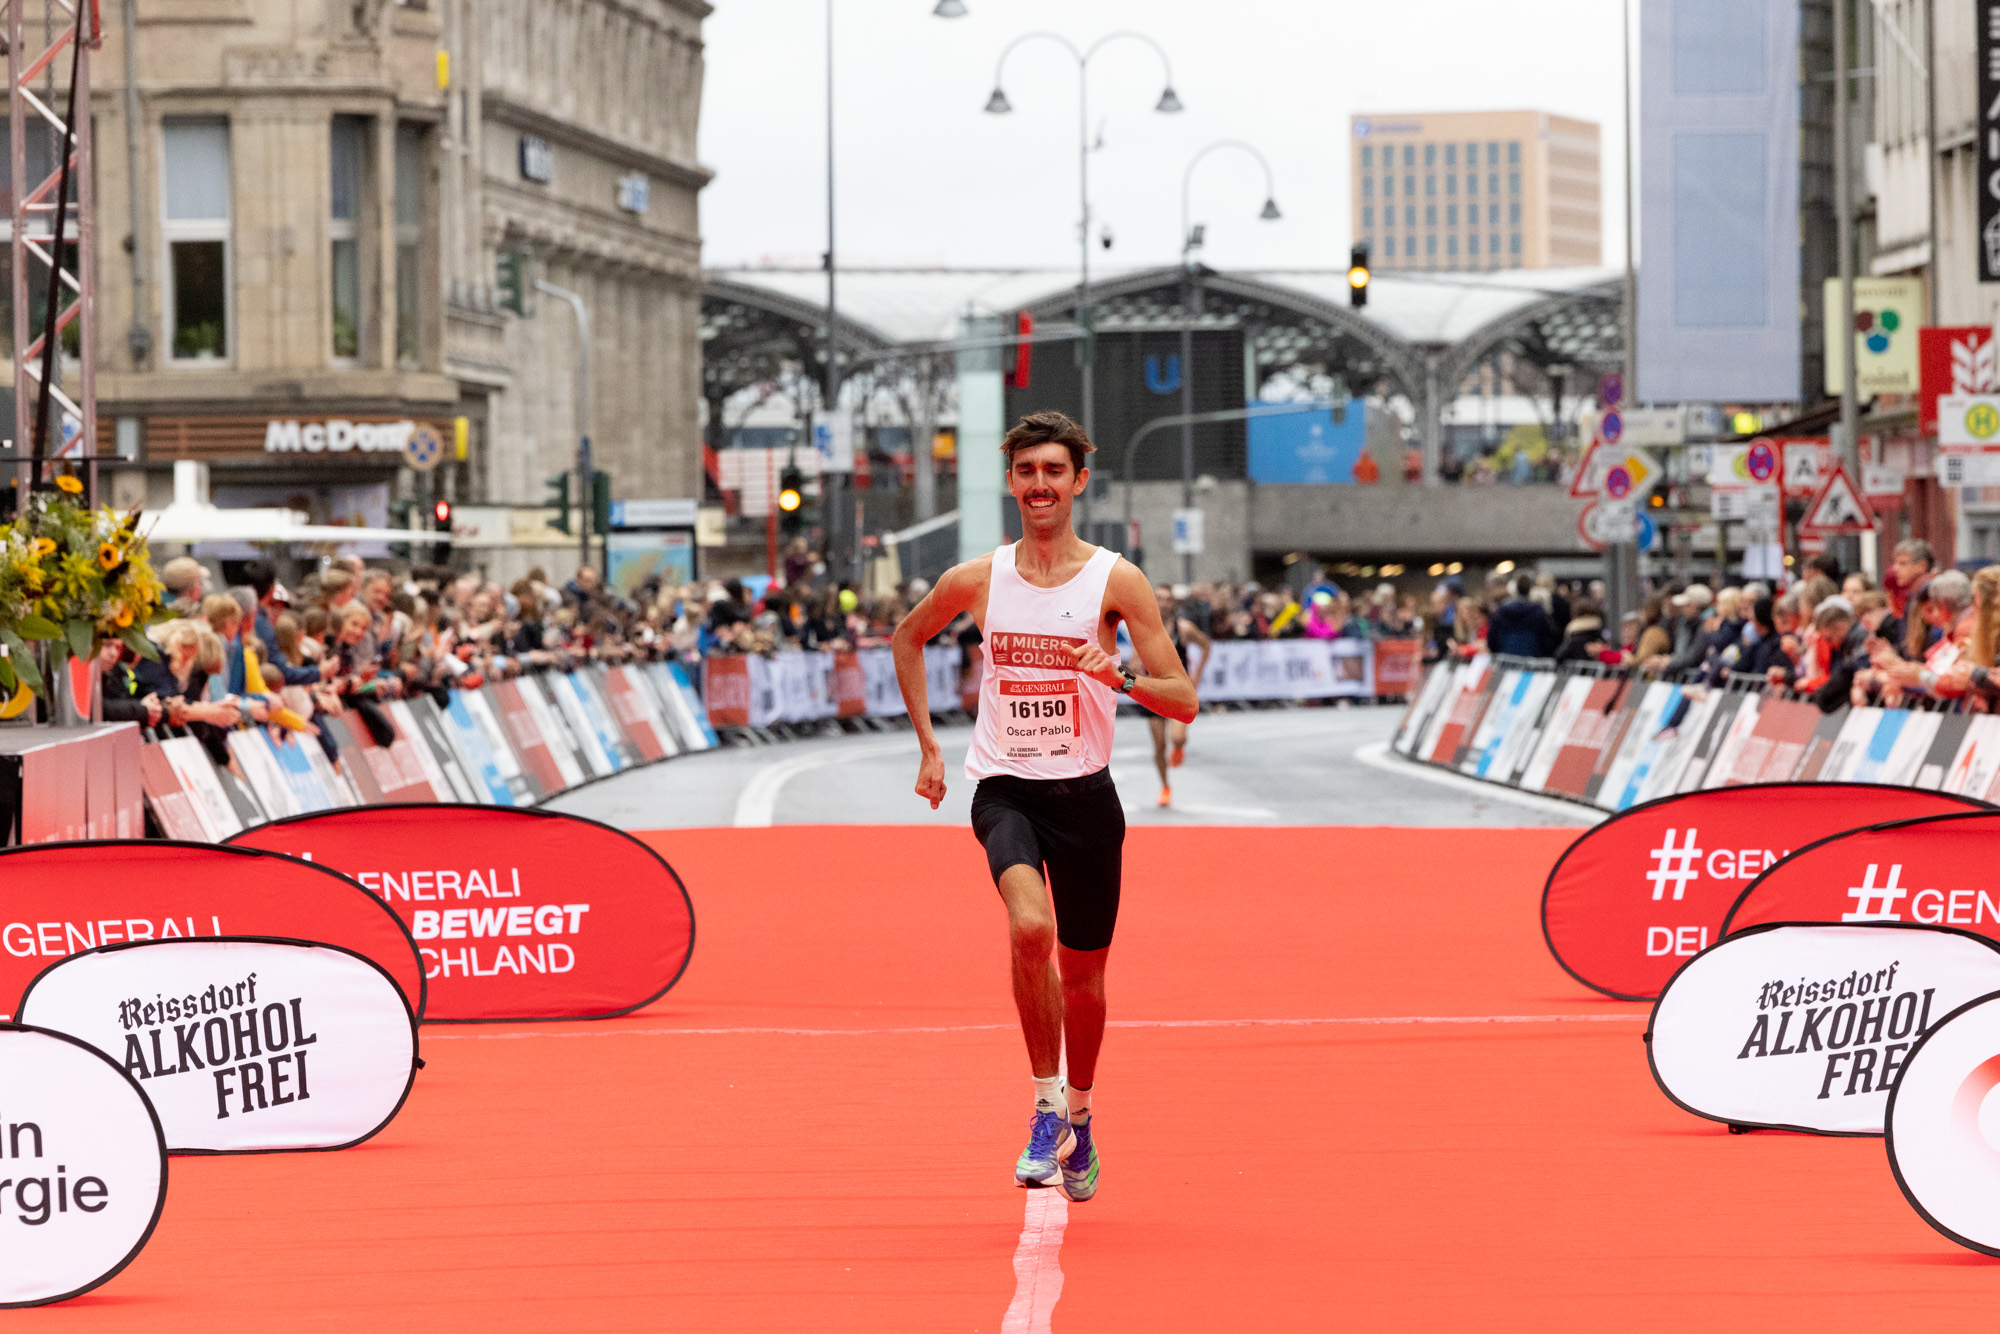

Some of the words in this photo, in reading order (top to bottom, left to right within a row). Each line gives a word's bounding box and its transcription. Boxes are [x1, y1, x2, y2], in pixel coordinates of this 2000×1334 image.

[264, 420, 414, 453] McDon
[1011, 652, 1073, 667] COLONI
[1021, 682, 1065, 693] GENERALI
[1009, 700, 1067, 719] 16150
[1006, 726, 1037, 737] Oscar
[1040, 724, 1072, 736] Pablo
[342, 867, 521, 901] ENERALI
[412, 904, 590, 940] BEWEGT
[1646, 926, 1708, 957] DE
[418, 943, 575, 979] CHLAND
[118, 972, 257, 1031] Reissdorf
[1756, 960, 1900, 1011] Reissdorf
[125, 997, 317, 1080] ALKOHOL
[212, 1050, 310, 1120] FREI
[1816, 1042, 1917, 1100] FRE
[0, 1112, 43, 1159] n
